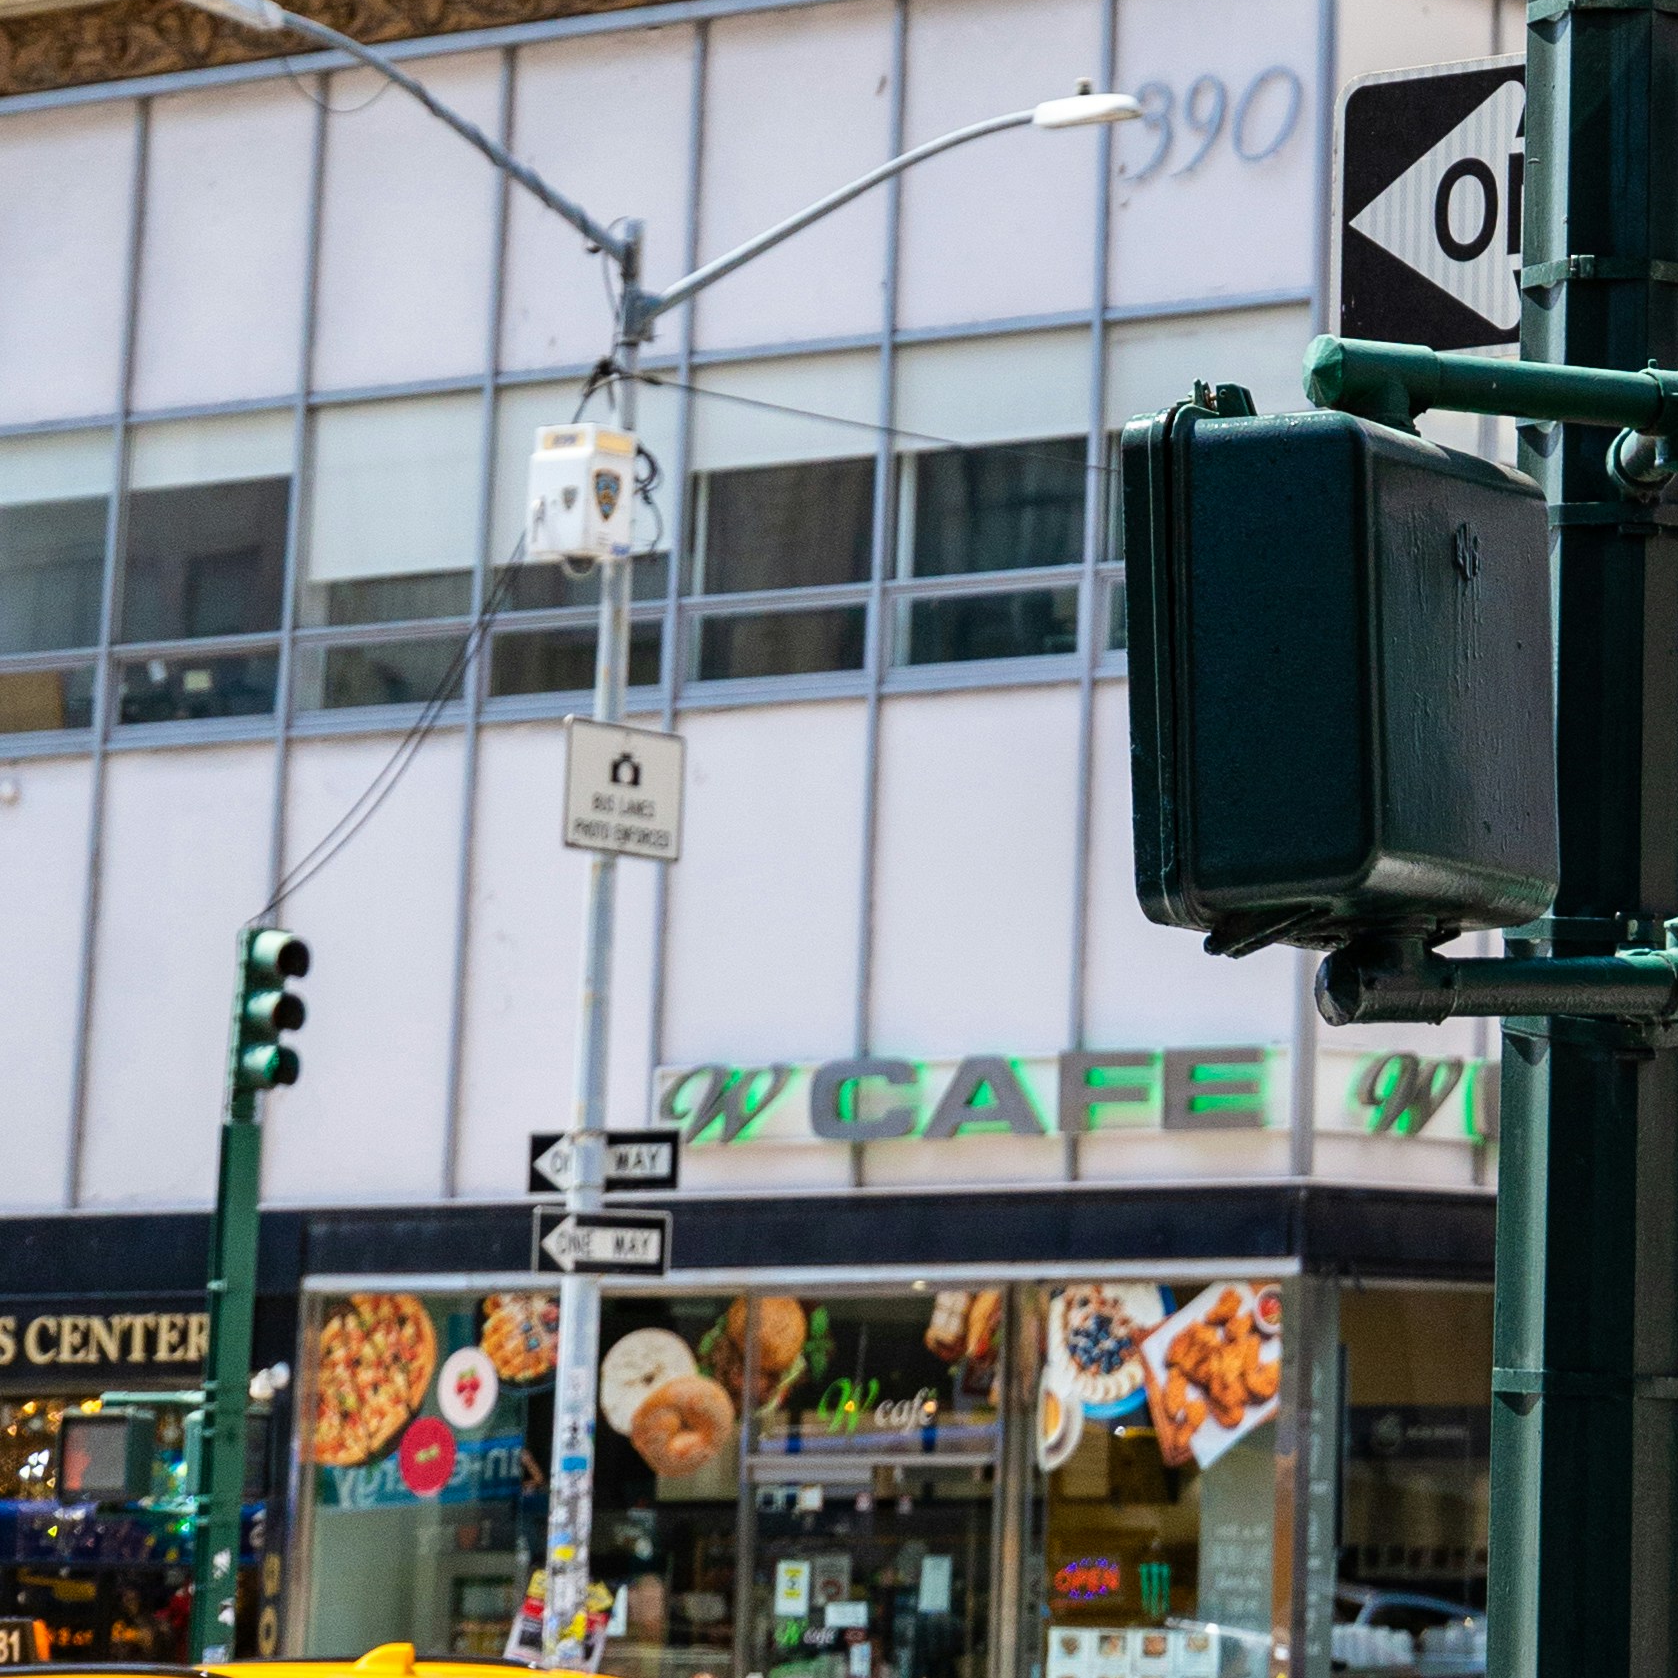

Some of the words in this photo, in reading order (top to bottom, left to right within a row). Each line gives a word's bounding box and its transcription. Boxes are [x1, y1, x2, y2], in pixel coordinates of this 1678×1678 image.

[1121, 64, 1304, 182] 390
[811, 1047, 1265, 1140] CAFE
[616, 1147, 660, 1172] WAY
[613, 1230, 652, 1256] WAY
